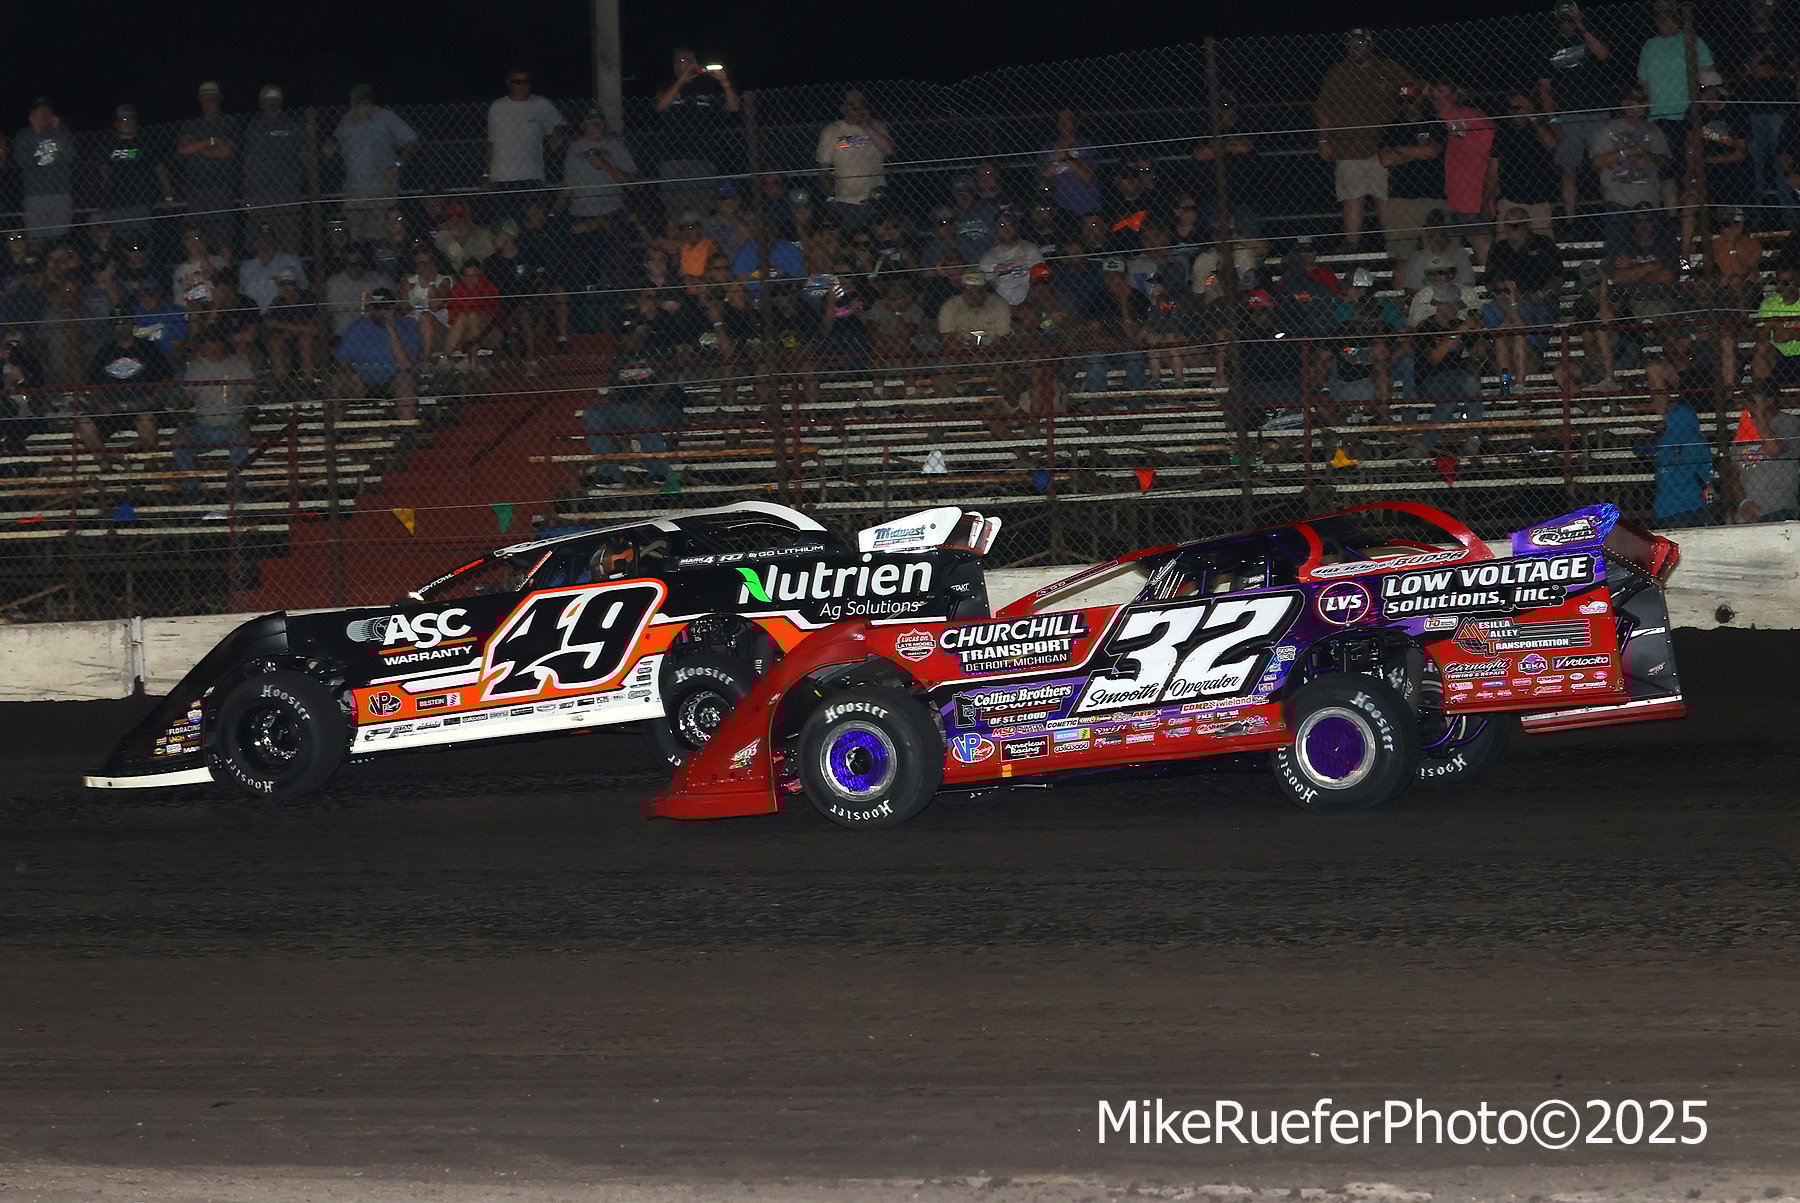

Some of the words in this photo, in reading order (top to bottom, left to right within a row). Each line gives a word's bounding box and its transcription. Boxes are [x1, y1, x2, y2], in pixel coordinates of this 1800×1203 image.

[874, 525, 926, 540] Midwest
[777, 545, 824, 555] LITHIUM
[735, 553, 933, 605] Nutrien
[1384, 570, 1457, 597] LOW
[1460, 556, 1589, 586] VOLTAGE
[819, 602, 842, 620] Ag
[845, 599, 919, 617] Solutions
[1325, 594, 1363, 612] LVS
[1388, 590, 1506, 614] solutions,
[383, 608, 472, 649] ASC
[939, 614, 1085, 649] CHURCHILL
[481, 582, 665, 701] 49
[959, 638, 1072, 663] TRANSPORT
[384, 645, 473, 666] WARRANTY
[1013, 654, 1067, 667] MICHIGAN
[1078, 596, 1295, 711] 32
[260, 684, 311, 720] Hoosier
[974, 693, 1016, 706] Collins
[1018, 685, 1073, 701] Brothers
[1085, 682, 1160, 709] Smooth
[1169, 674, 1241, 697] Operator
[1218, 696, 1252, 707] wieland
[824, 701, 888, 724] Hoosier
[984, 698, 1061, 711] TOWING
[990, 717, 1002, 725] OF
[1017, 712, 1047, 721] CLOUD
[1047, 719, 1078, 728] COMETIC
[1349, 690, 1394, 752] Hoosier
[952, 733, 983, 762] VP
[1005, 741, 1046, 750] American
[1419, 752, 1468, 780] Hoosi
[829, 799, 894, 821] Hoosier
